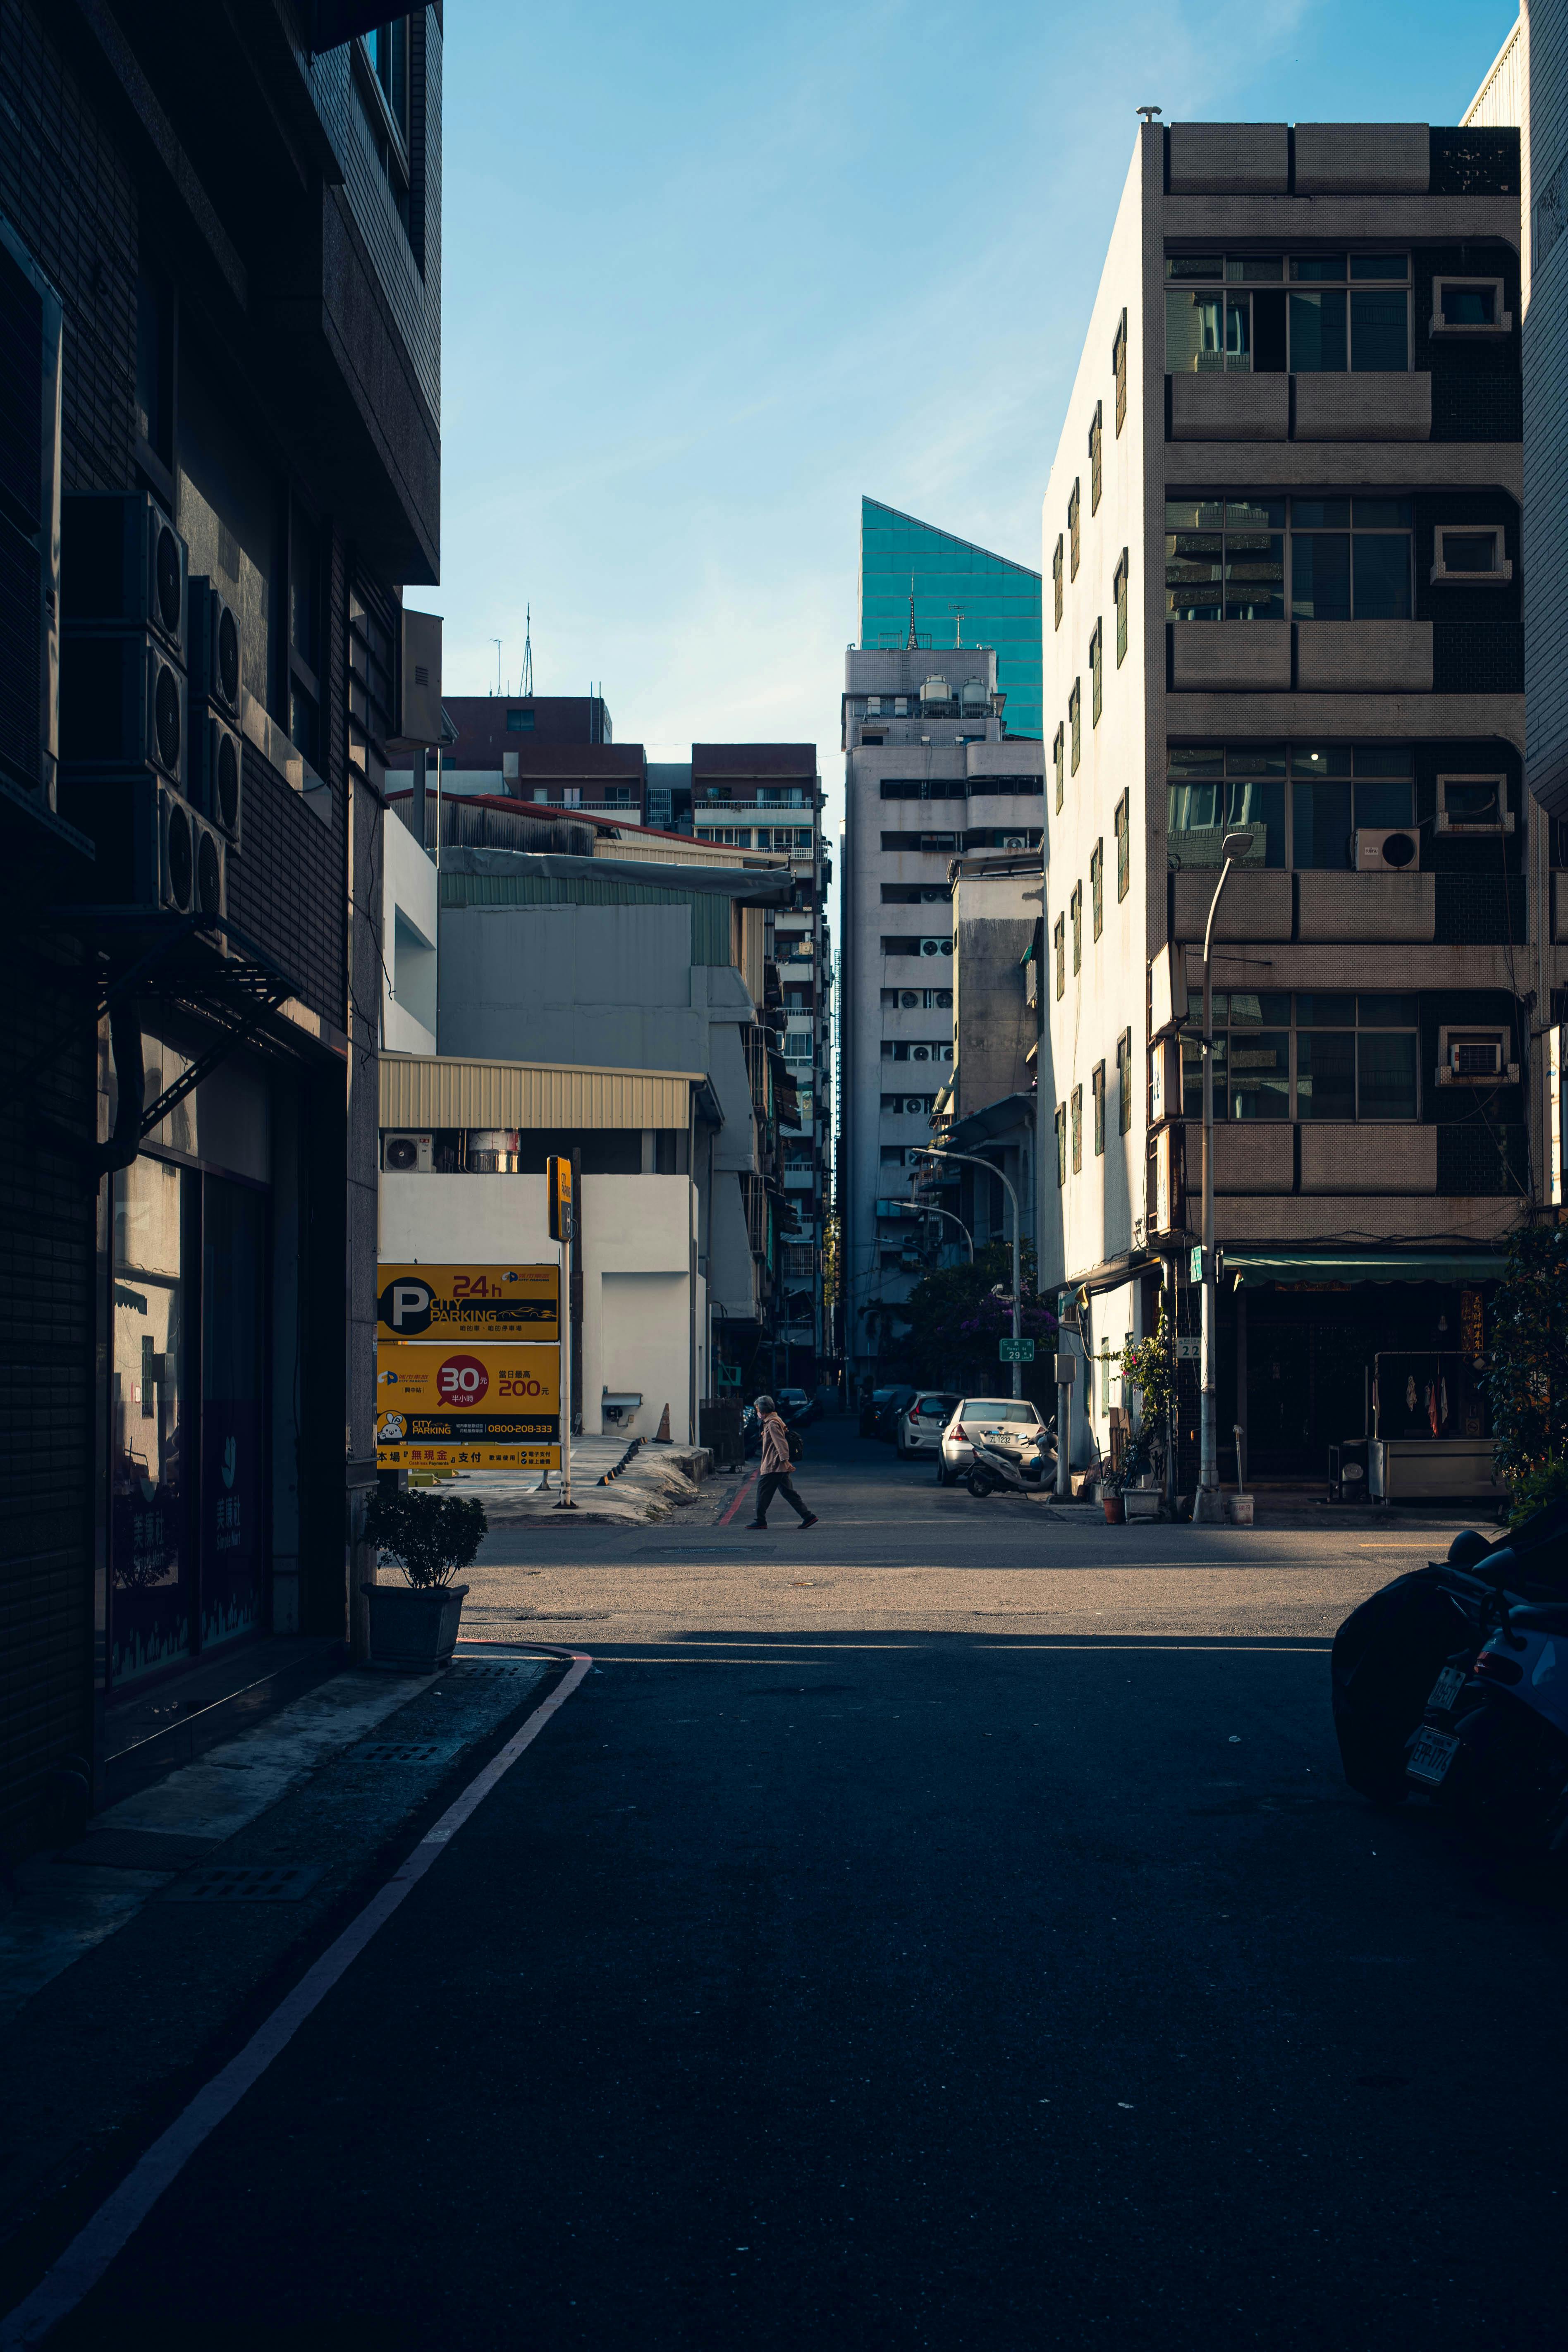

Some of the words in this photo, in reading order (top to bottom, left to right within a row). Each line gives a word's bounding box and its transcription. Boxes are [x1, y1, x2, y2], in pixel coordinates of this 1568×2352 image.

[394, 1287, 429, 1325] P
[430, 1298, 463, 1310] CITY
[430, 1310, 497, 1322] PARKING
[1183, 1346, 1199, 1355] 22
[499, 1370, 531, 1379] 當日最高
[217, 1495, 241, 1530] 美廉社
[217, 1532, 232, 1552] Simple
[232, 1530, 241, 1545] Mart
